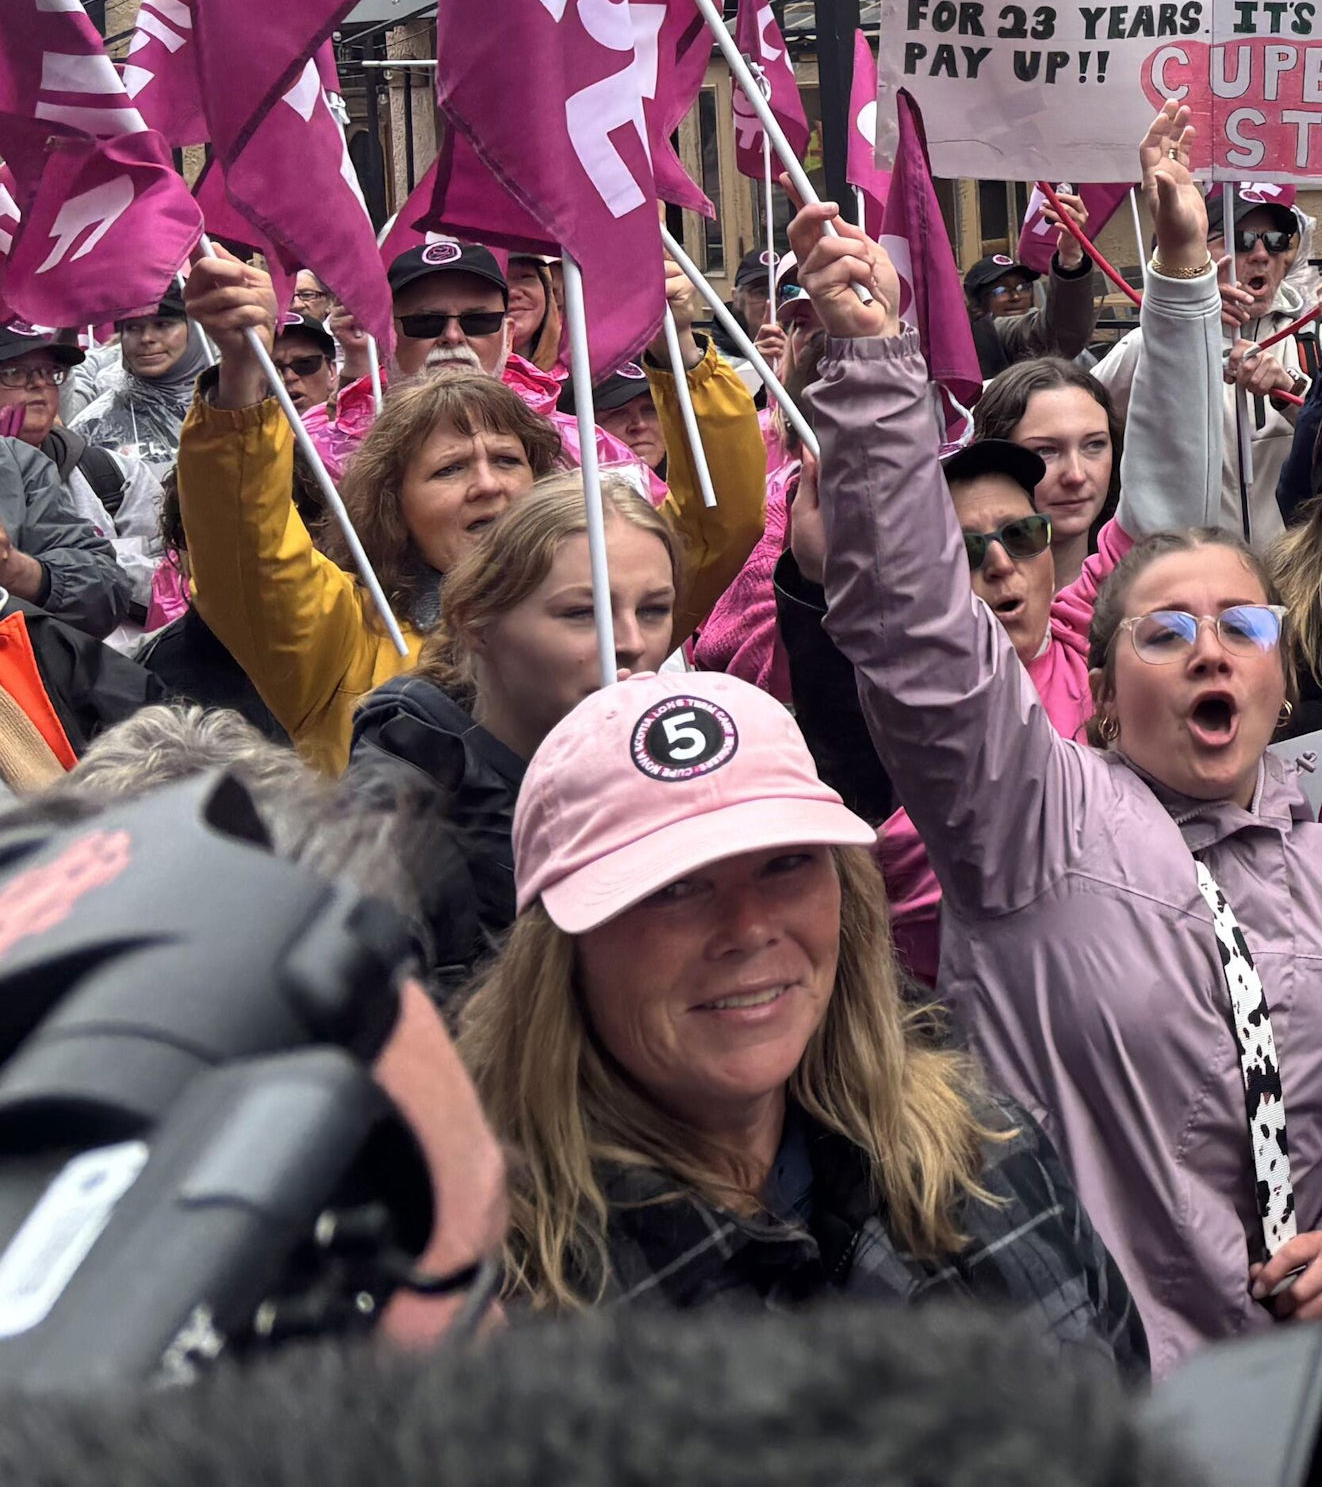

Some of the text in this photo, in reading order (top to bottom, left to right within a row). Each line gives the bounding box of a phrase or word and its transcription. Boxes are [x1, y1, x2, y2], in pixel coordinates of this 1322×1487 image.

[997, 5, 1057, 40] 23
[1079, 1, 1210, 40] YEARS.
[1234, 1, 1315, 34] IT'S
[904, 42, 1110, 84] PAY UP!!
[652, 698, 685, 719] LONG
[662, 712, 706, 760] 5
